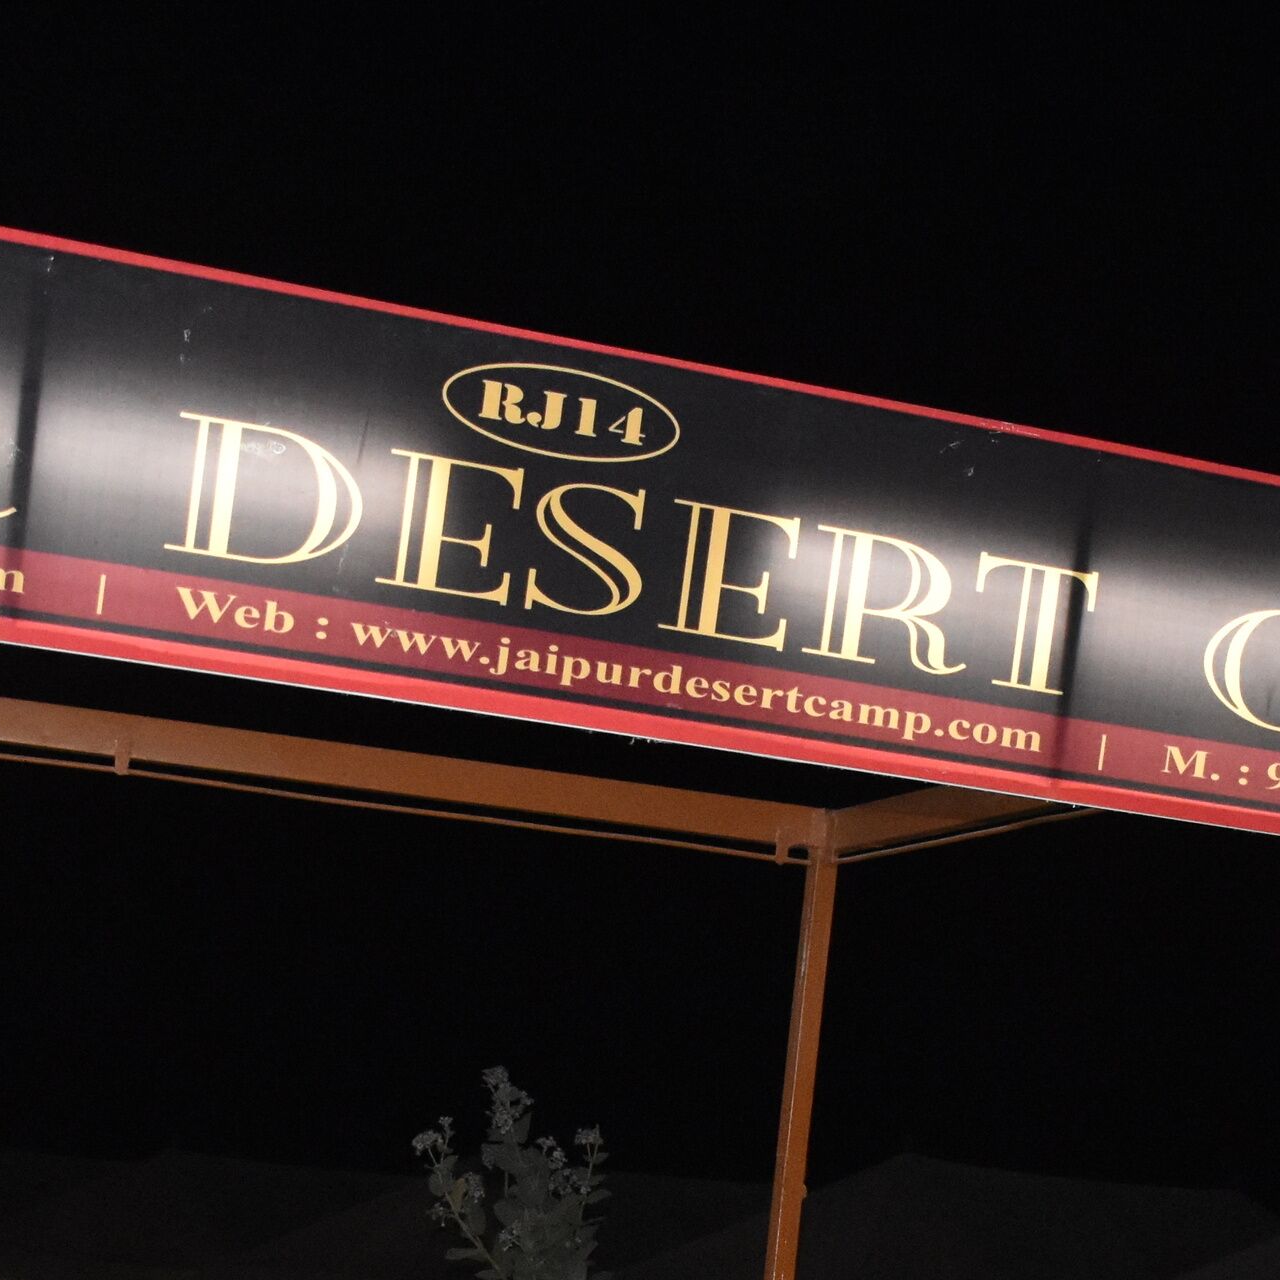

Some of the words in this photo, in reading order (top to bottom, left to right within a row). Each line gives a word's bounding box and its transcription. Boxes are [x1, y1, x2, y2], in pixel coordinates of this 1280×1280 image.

[478, 378, 646, 447] RJ14
[163, 411, 1099, 695] DESERT
[176, 585, 293, 636] Web
[352, 619, 1042, 753] www.jaipurdesertcamp.com
[1161, 743, 1220, 781] M.
